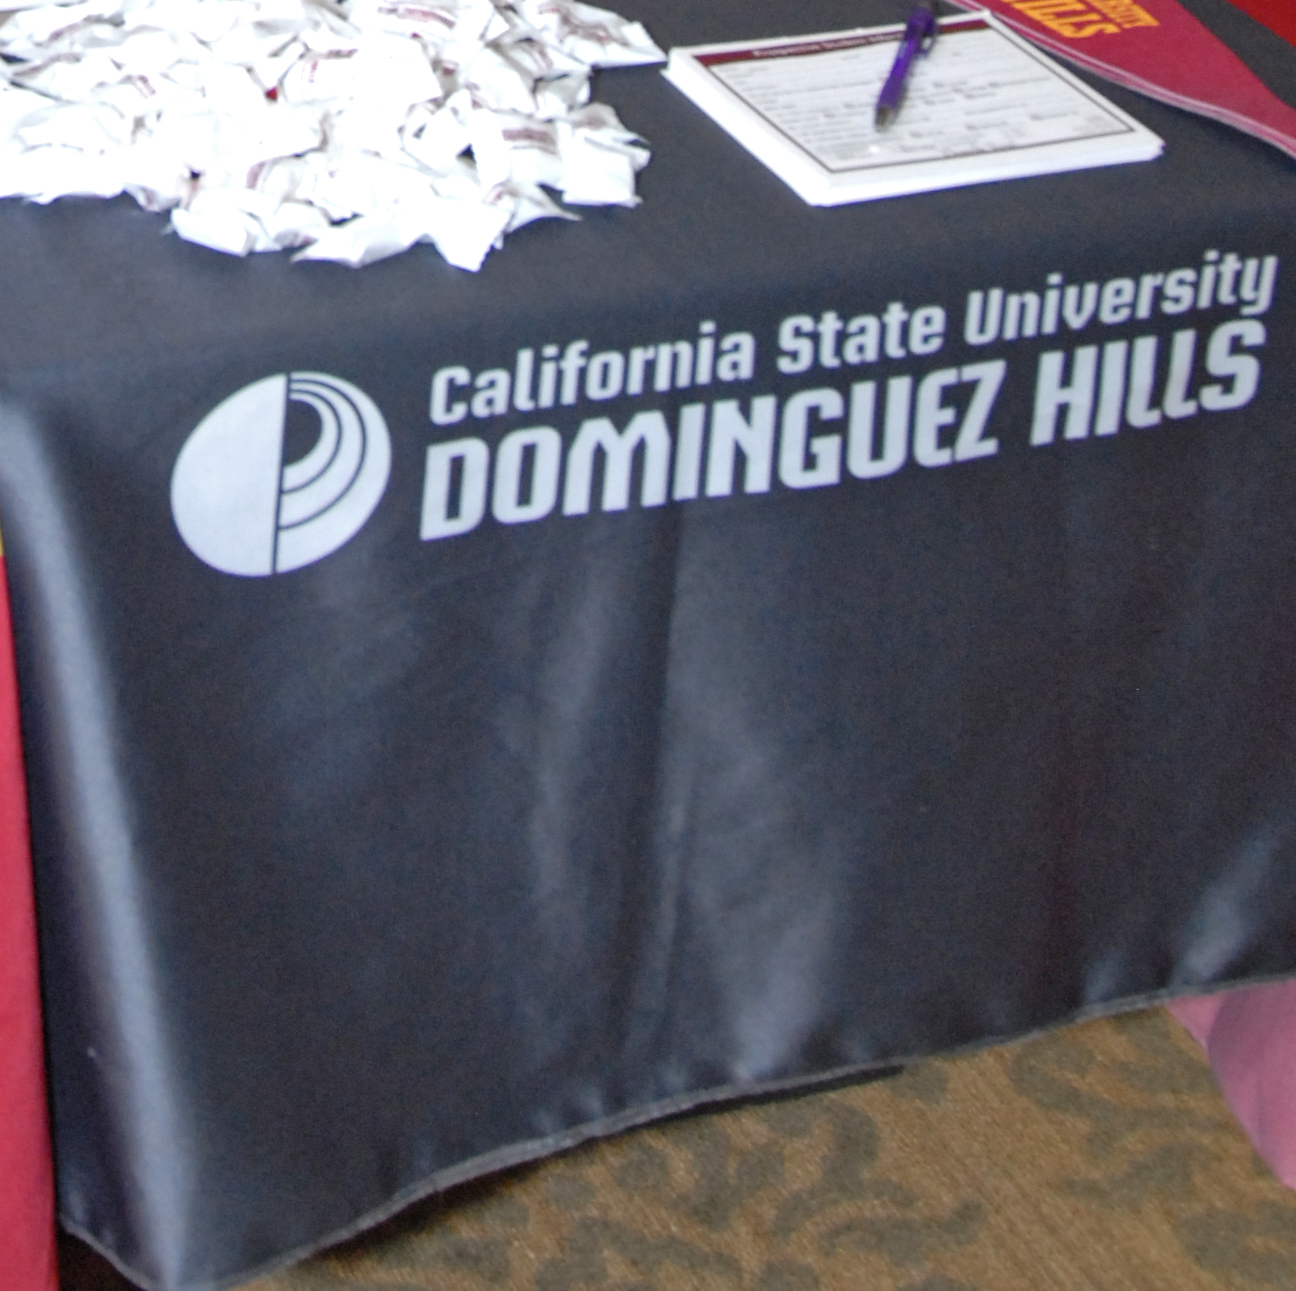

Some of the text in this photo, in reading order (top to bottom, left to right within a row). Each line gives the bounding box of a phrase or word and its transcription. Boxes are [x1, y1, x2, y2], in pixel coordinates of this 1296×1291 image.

[419, 319, 1268, 542] DOMINGUEZ HILLS
[430, 249, 1279, 425] California State University
